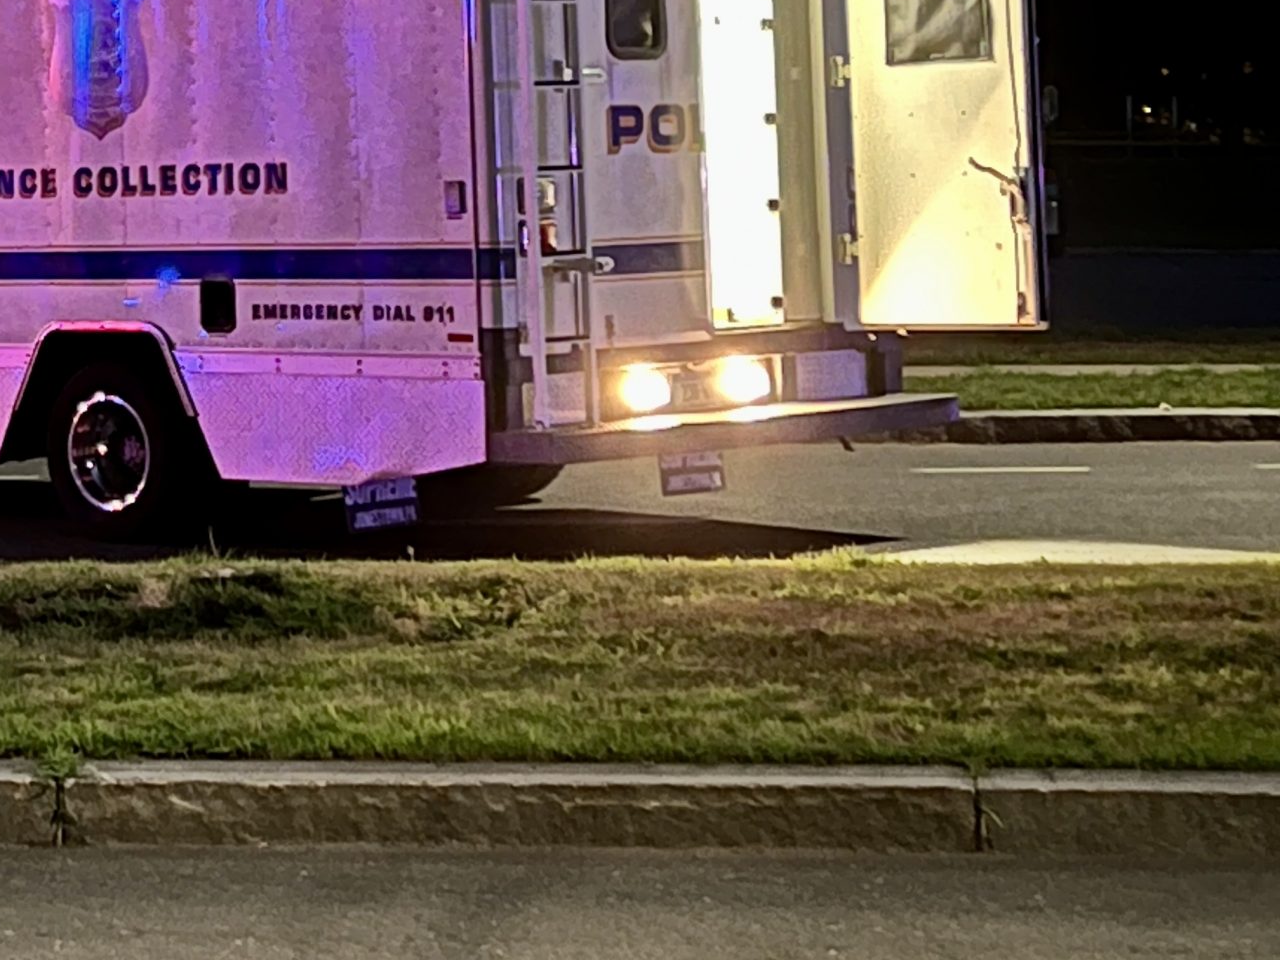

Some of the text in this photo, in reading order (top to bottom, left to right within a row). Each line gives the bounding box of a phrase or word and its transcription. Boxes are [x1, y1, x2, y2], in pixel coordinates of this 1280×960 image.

[72, 162, 289, 197] COLLECTION
[251, 304, 455, 322] EMERGENCY DIAL 911
